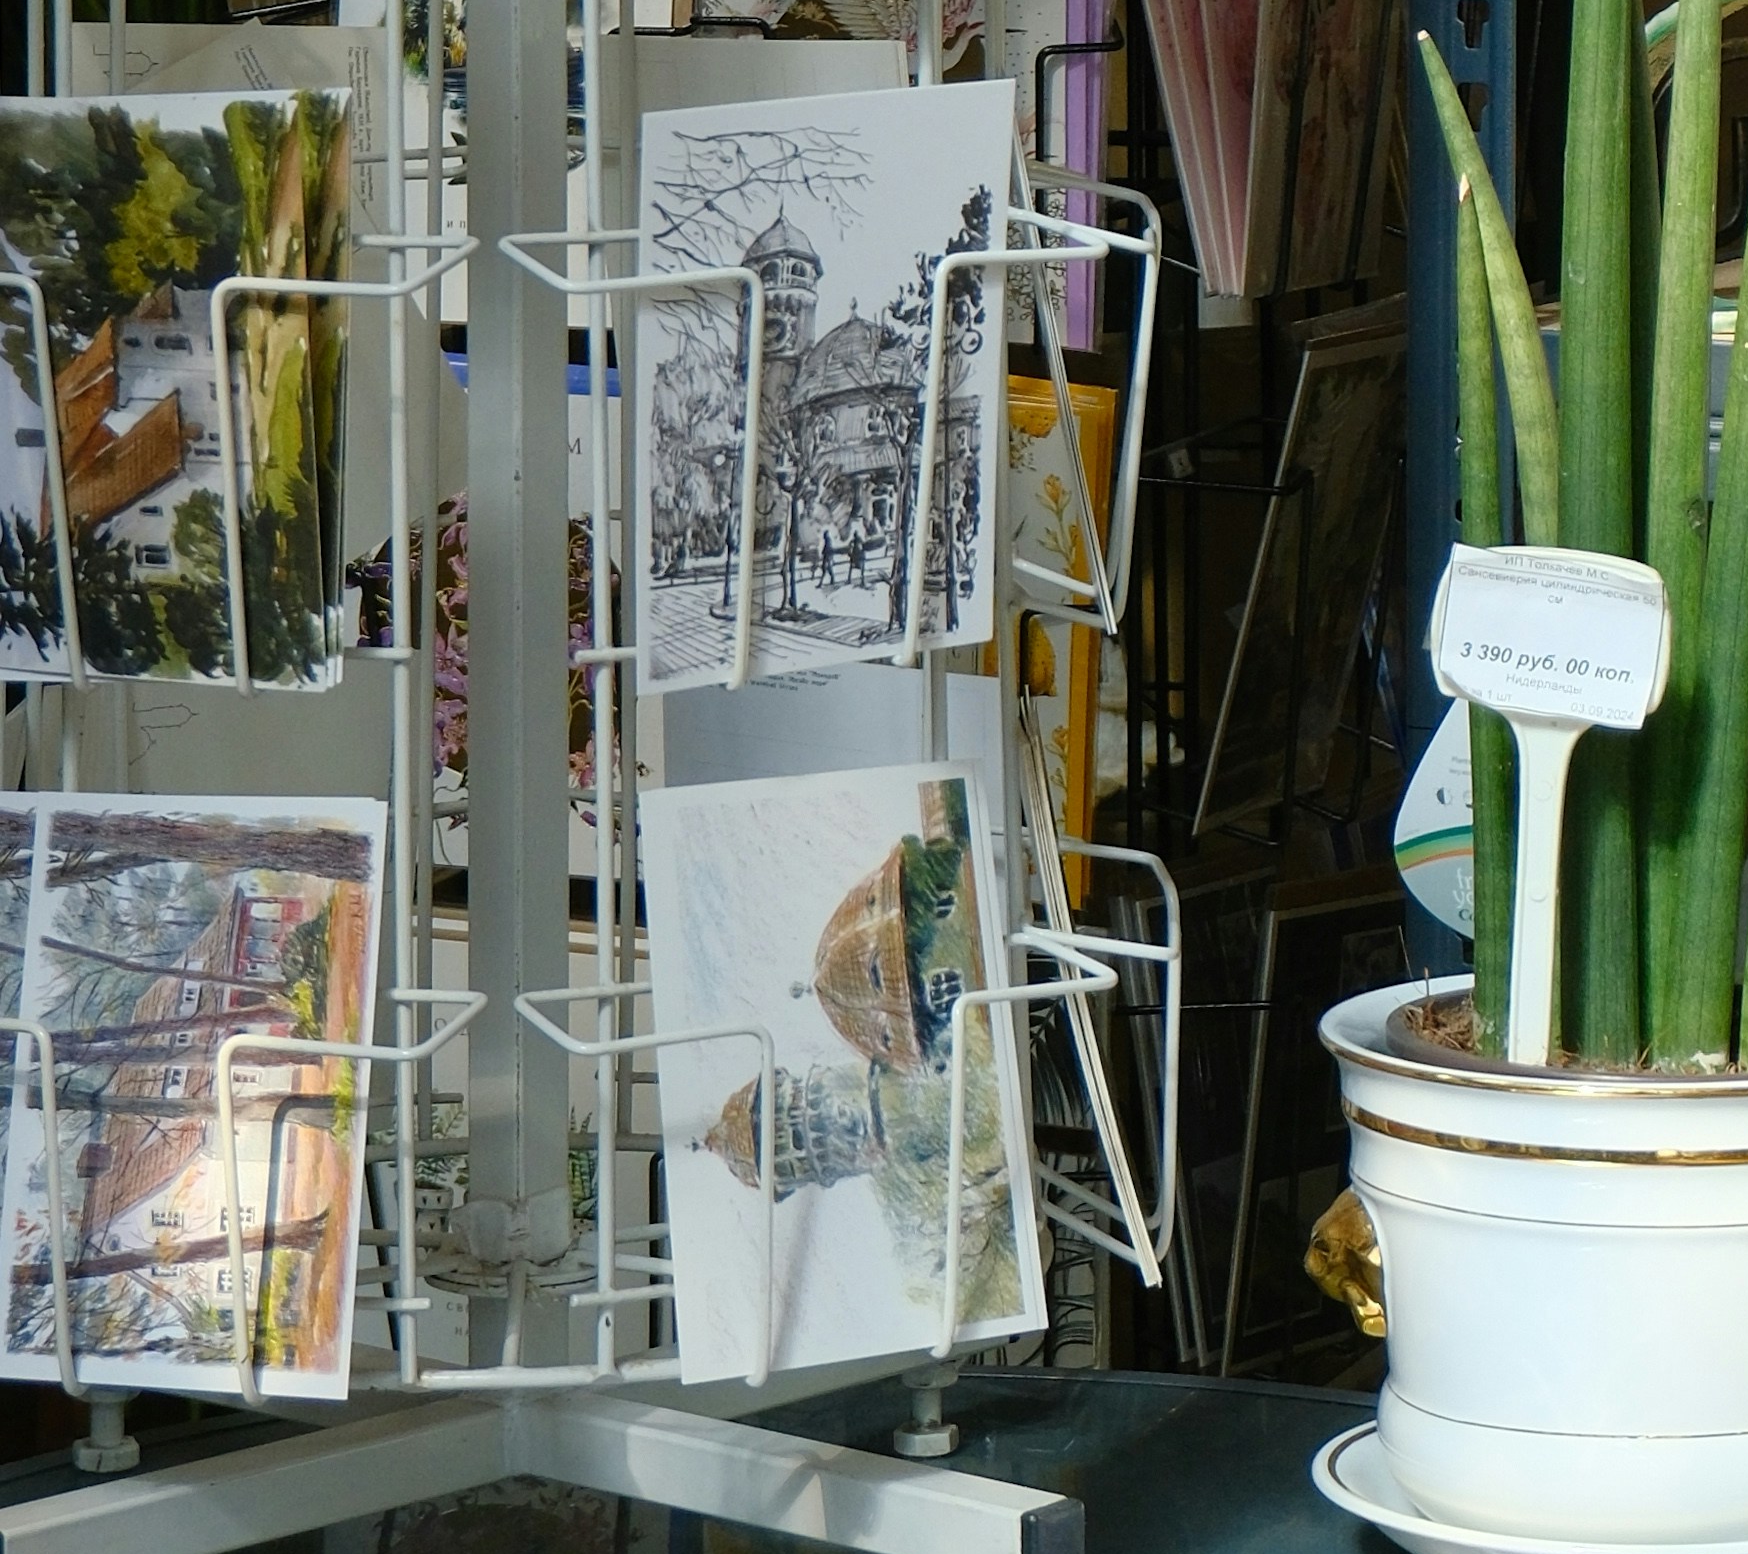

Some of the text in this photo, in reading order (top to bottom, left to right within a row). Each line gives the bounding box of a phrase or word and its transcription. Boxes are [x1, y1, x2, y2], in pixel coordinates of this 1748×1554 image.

[1460, 641, 1473, 658] 3
[1477, 643, 1513, 663] 390
[1516, 653, 1559, 673] руб.
[1566, 657, 1590, 676] 00
[1505, 673, 1583, 695] Нидерланды
